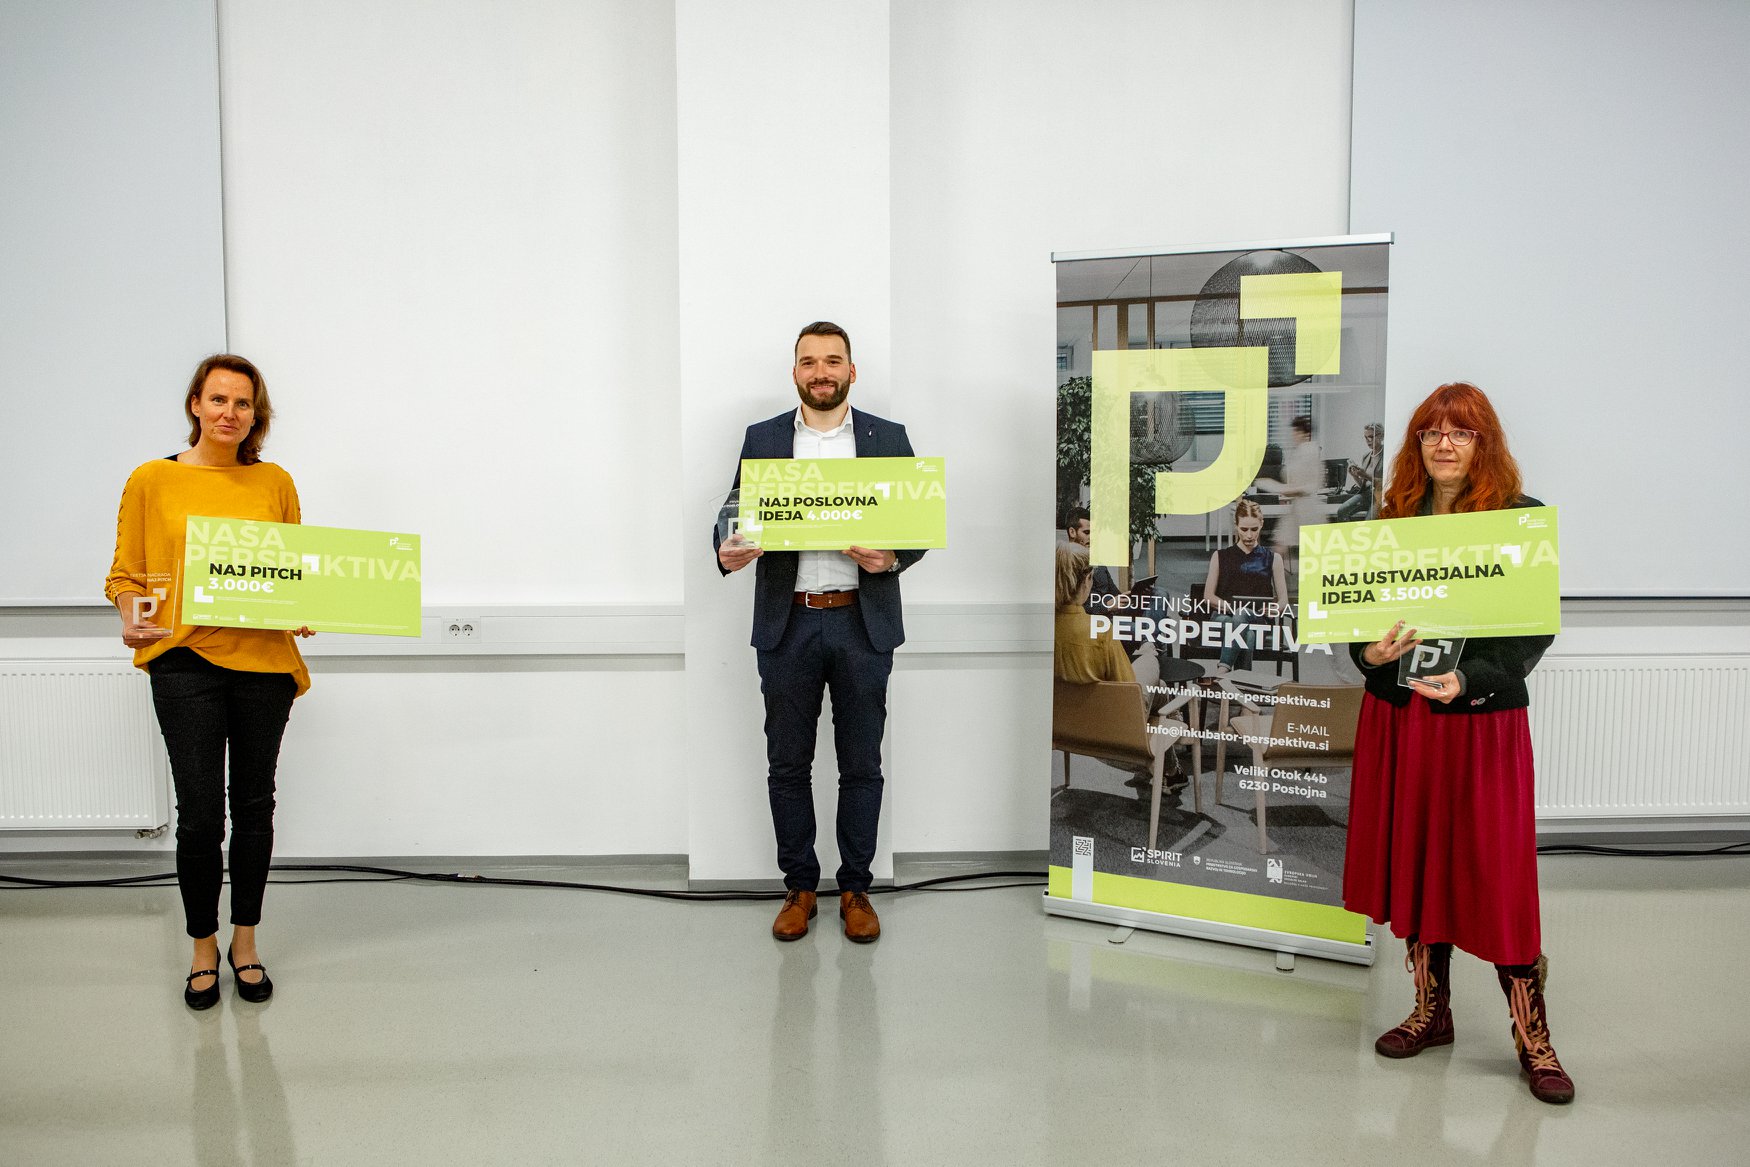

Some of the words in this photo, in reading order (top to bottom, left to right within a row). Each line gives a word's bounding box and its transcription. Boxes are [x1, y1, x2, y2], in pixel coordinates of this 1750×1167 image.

[759, 497, 790, 507] NAJ
[793, 496, 878, 507] POSLOVNA
[759, 510, 804, 521] IDEJA
[806, 509, 863, 521] 4.000€
[185, 519, 286, 550] NAŠA
[1300, 522, 1400, 556] NAŠA
[209, 562, 247, 577] NAJ
[250, 566, 302, 581] PITCH
[1322, 572, 1359, 588] NAJ
[1362, 563, 1505, 586] USTVARJALNA
[207, 576, 275, 594] 3.000€
[1322, 589, 1376, 605] IDEJA
[1379, 585, 1449, 602] 3.500€
[1090, 593, 1211, 615] PODJETNIŠKI
[1217, 599, 1299, 620] INKUBA
[1146, 684, 1331, 709] www.inkubator-perspektiva.si
[1146, 723, 1330, 751] info@inkubator-perspektiva.si
[1286, 722, 1330, 737] E-MAIL
[1234, 764, 1269, 778] Veliki
[1270, 768, 1302, 781] Otok
[1303, 771, 1328, 784] 44b
[1238, 779, 1270, 792] 6230
[1272, 783, 1327, 799] Postojna
[1146, 858, 1181, 868] SLOVENIA
[1147, 849, 1183, 862] SPIRIT
